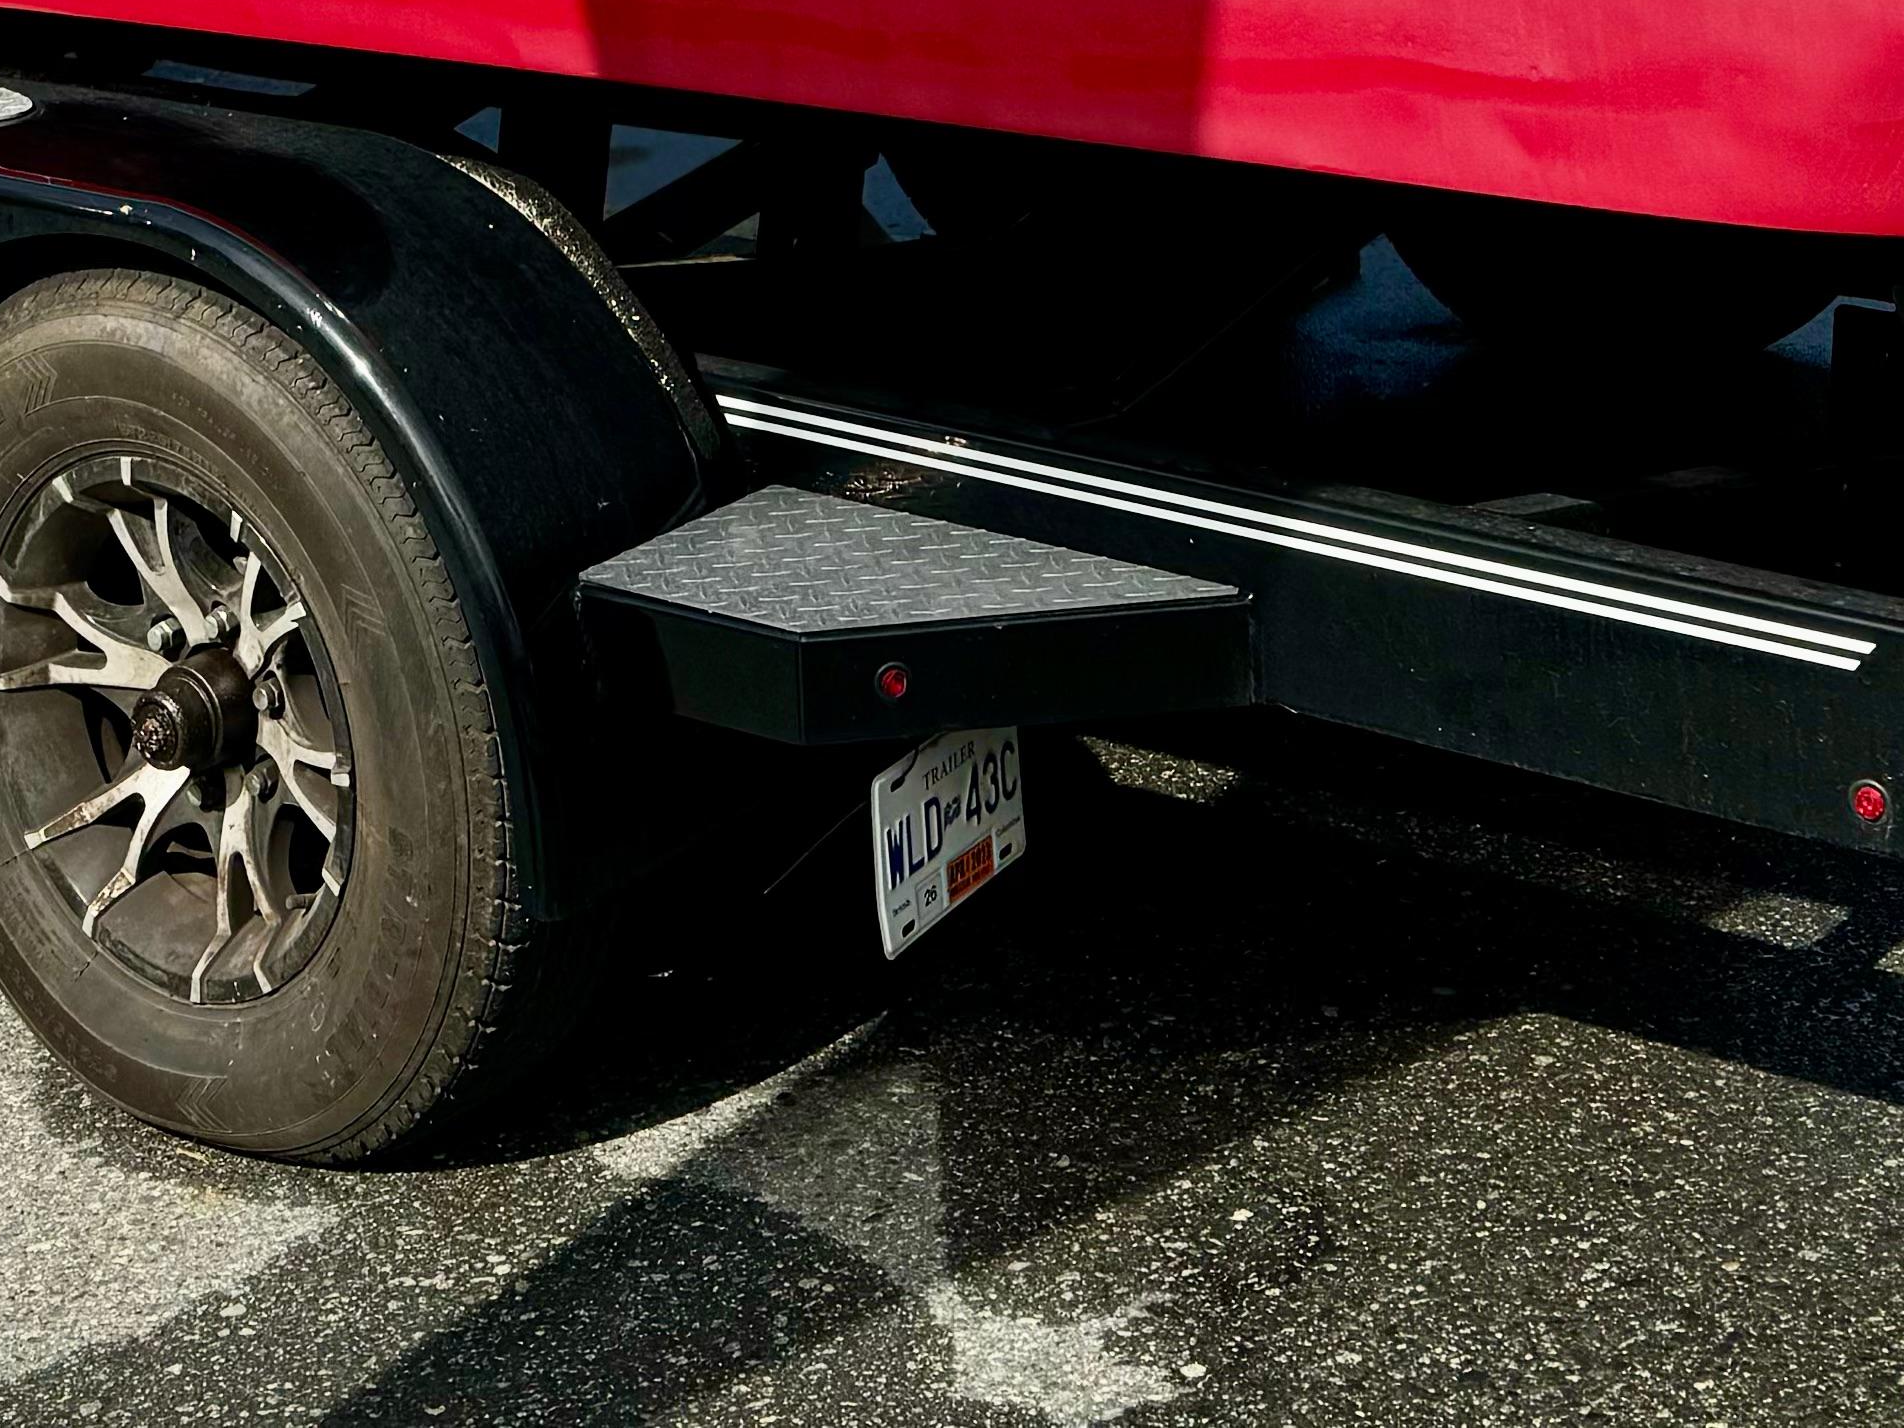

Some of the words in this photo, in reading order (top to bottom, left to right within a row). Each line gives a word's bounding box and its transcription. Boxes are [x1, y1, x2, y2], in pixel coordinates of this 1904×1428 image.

[922, 740, 976, 792] TRAILER
[885, 795, 944, 892] WLD
[964, 739, 1019, 827] 43C
[923, 884, 938, 908] 26
